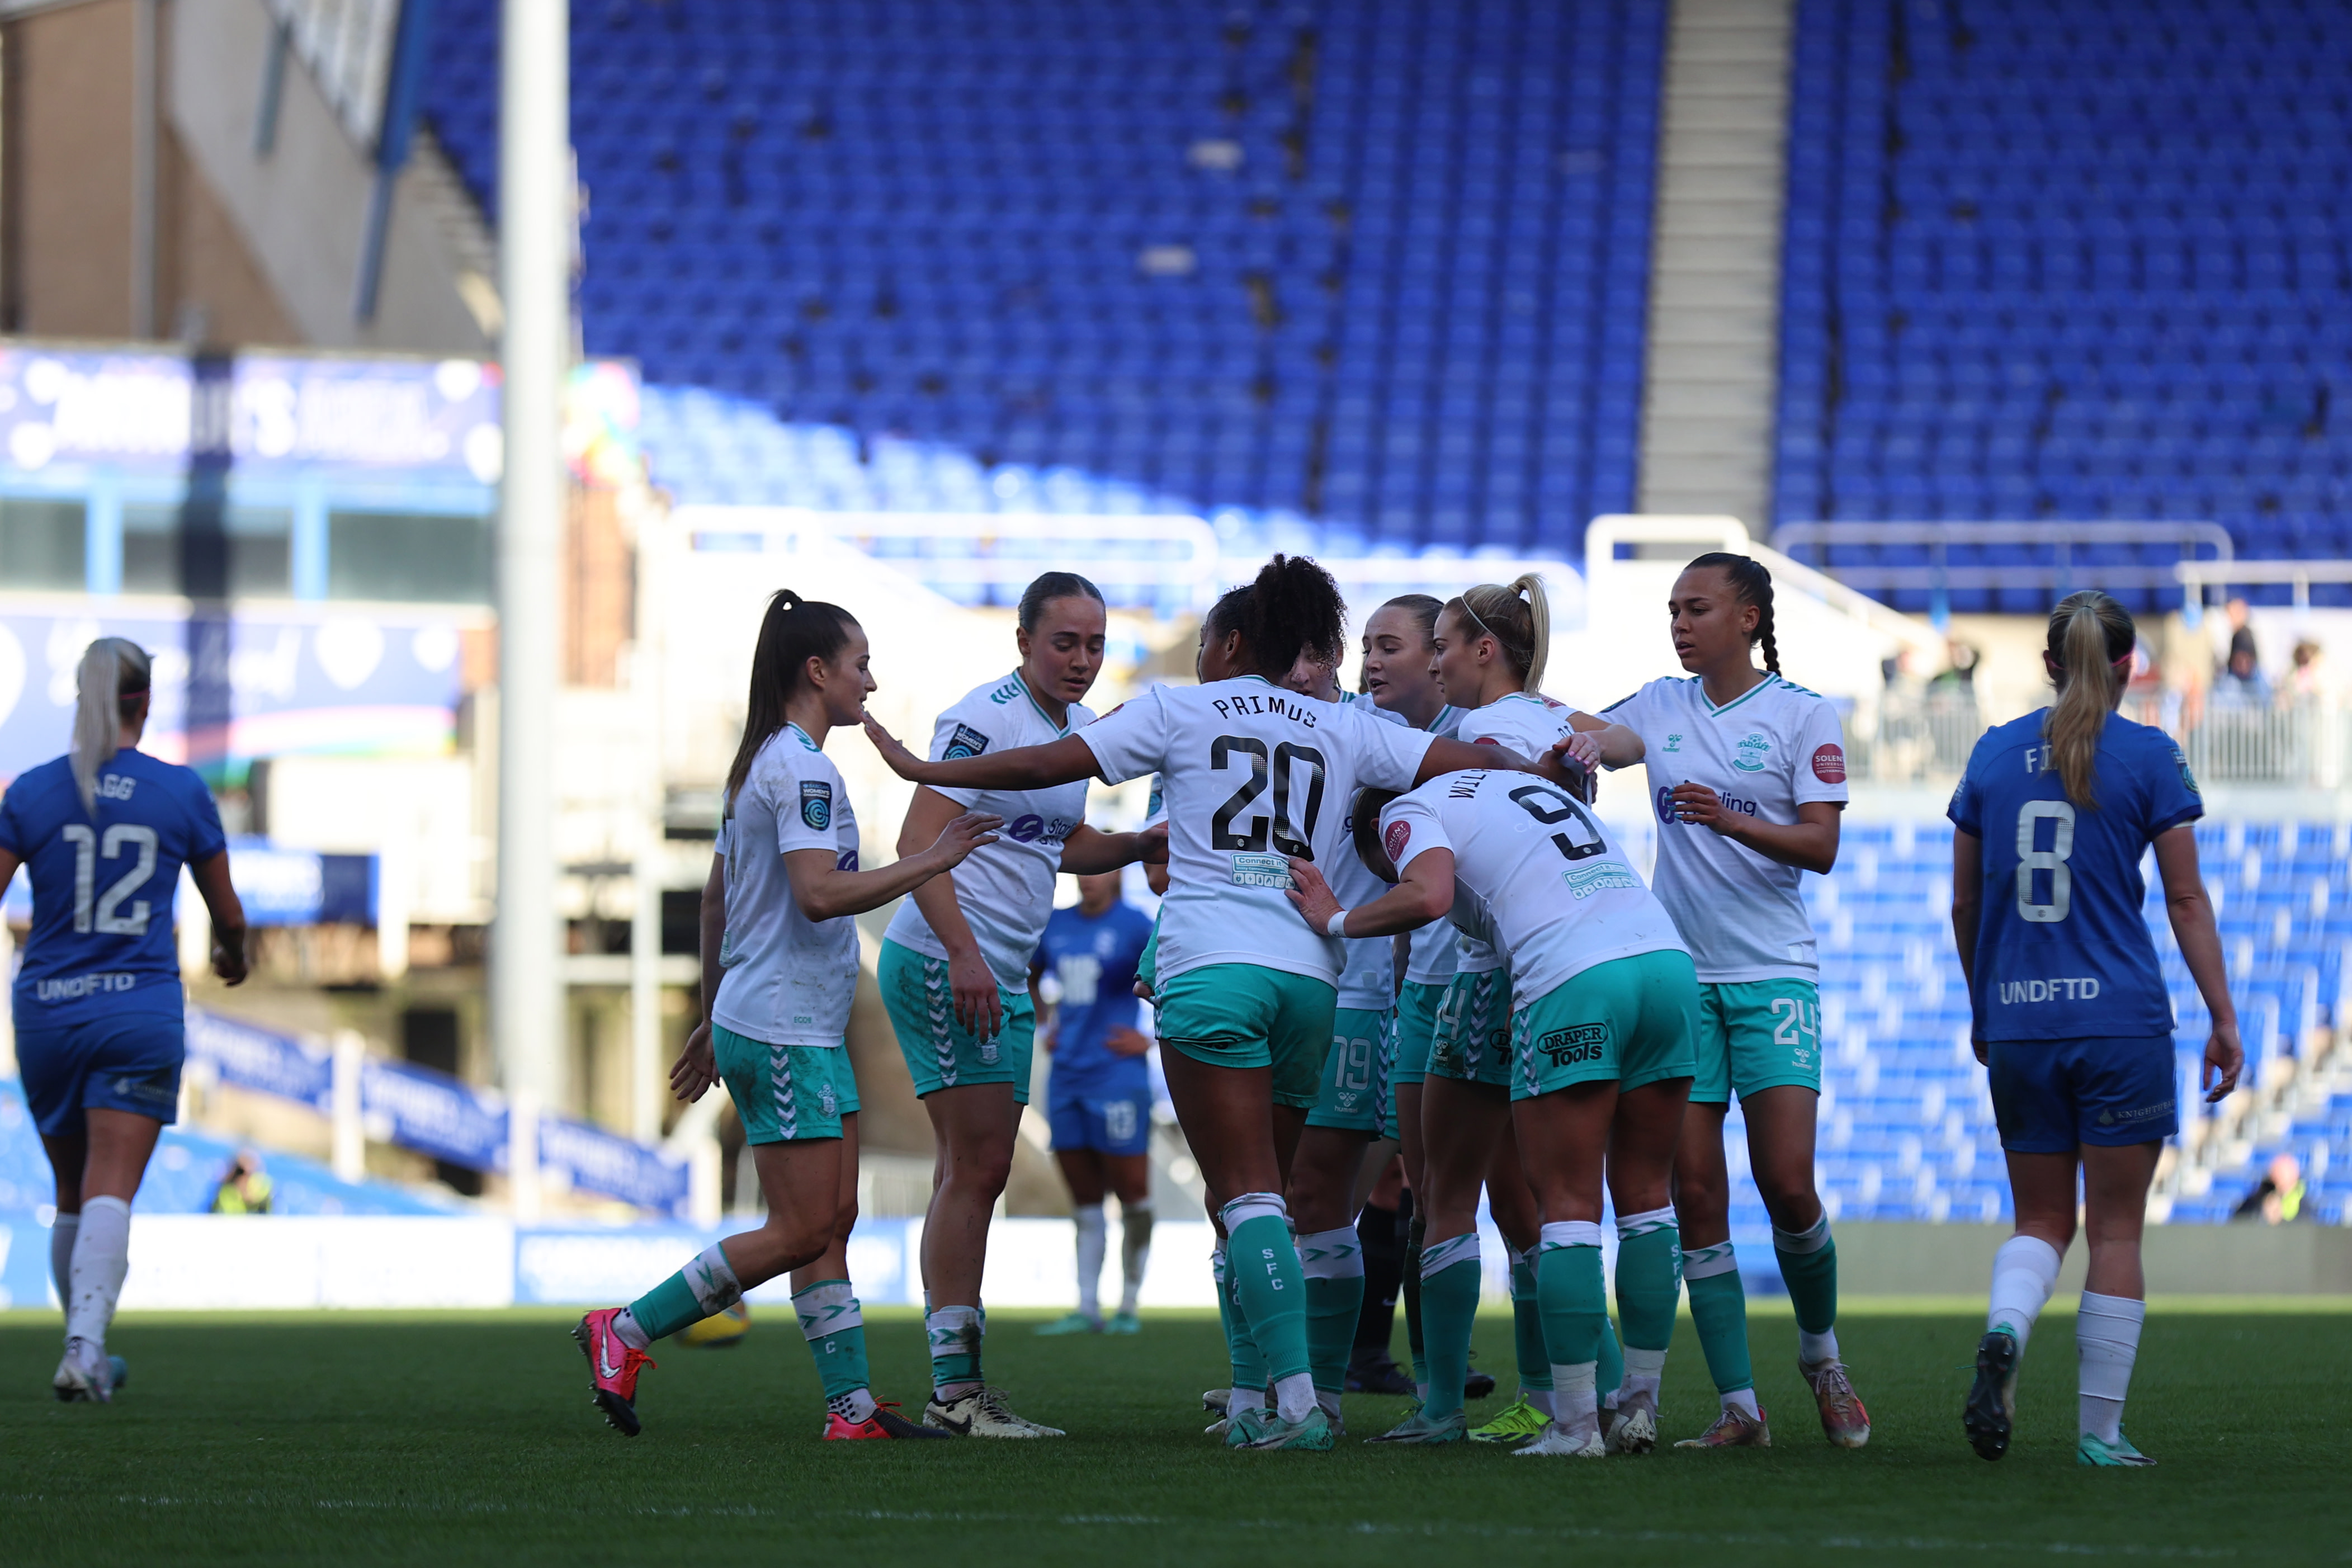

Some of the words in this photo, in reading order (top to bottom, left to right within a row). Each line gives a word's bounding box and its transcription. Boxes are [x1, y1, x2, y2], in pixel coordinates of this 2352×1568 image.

[1212, 696, 1317, 728] PRIMUS
[1210, 734, 1325, 862] 20
[1388, 823, 1404, 852] SOLENT
[1508, 785, 1608, 861] 9
[1239, 857, 1274, 866] Connect
[1571, 865, 1605, 880] Connect
[2016, 800, 2076, 923] 8
[62, 823, 159, 936] 12
[37, 972, 136, 1001] UNDFTD
[2000, 977, 2100, 1004] UNDFTD
[1544, 1027, 1603, 1050] DRAPER
[1771, 998, 1817, 1052] 24
[1334, 1035, 1371, 1090] 19
[1548, 1042, 1603, 1068] Tools
[1334, 1105, 1358, 1113] hummel
